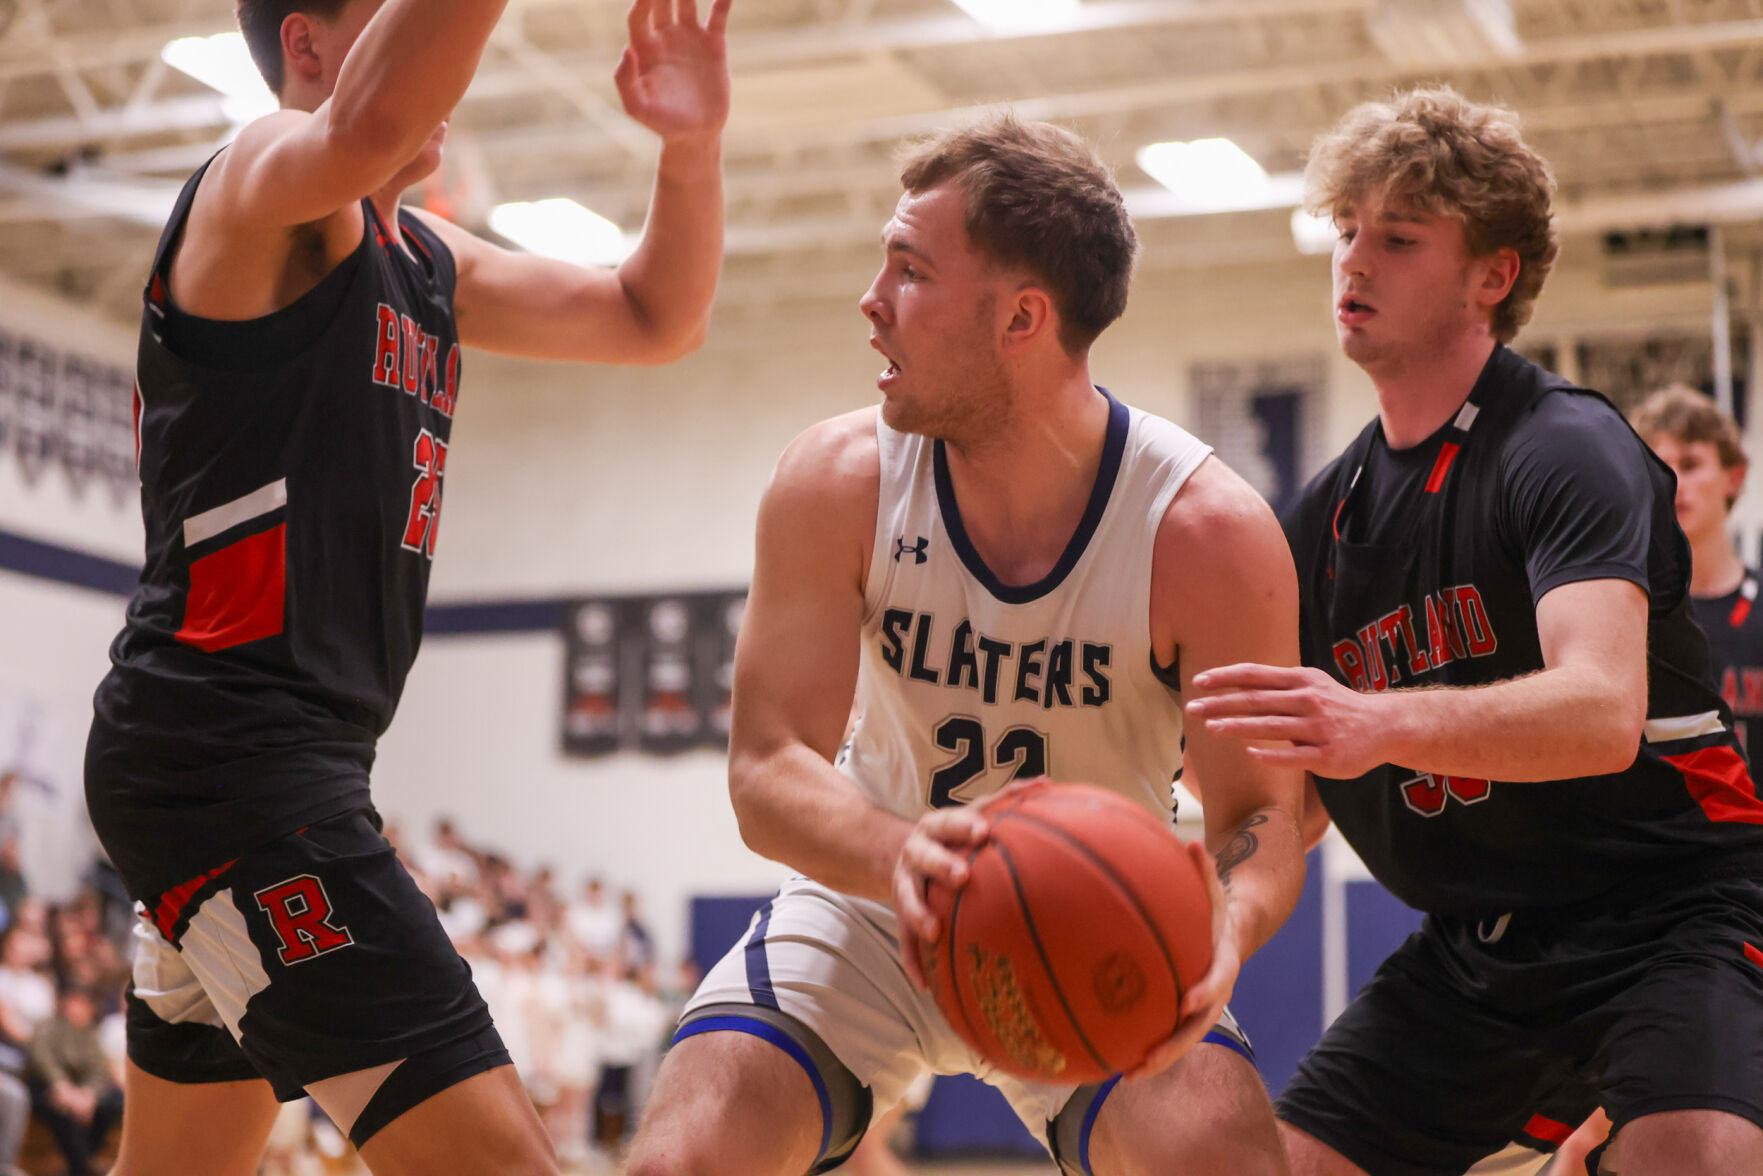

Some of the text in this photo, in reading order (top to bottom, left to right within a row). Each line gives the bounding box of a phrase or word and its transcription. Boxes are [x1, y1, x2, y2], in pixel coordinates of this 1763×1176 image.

[880, 605, 1114, 711] SLATERS
[1332, 584, 1498, 692] RUTLAND
[253, 873, 355, 967] R
